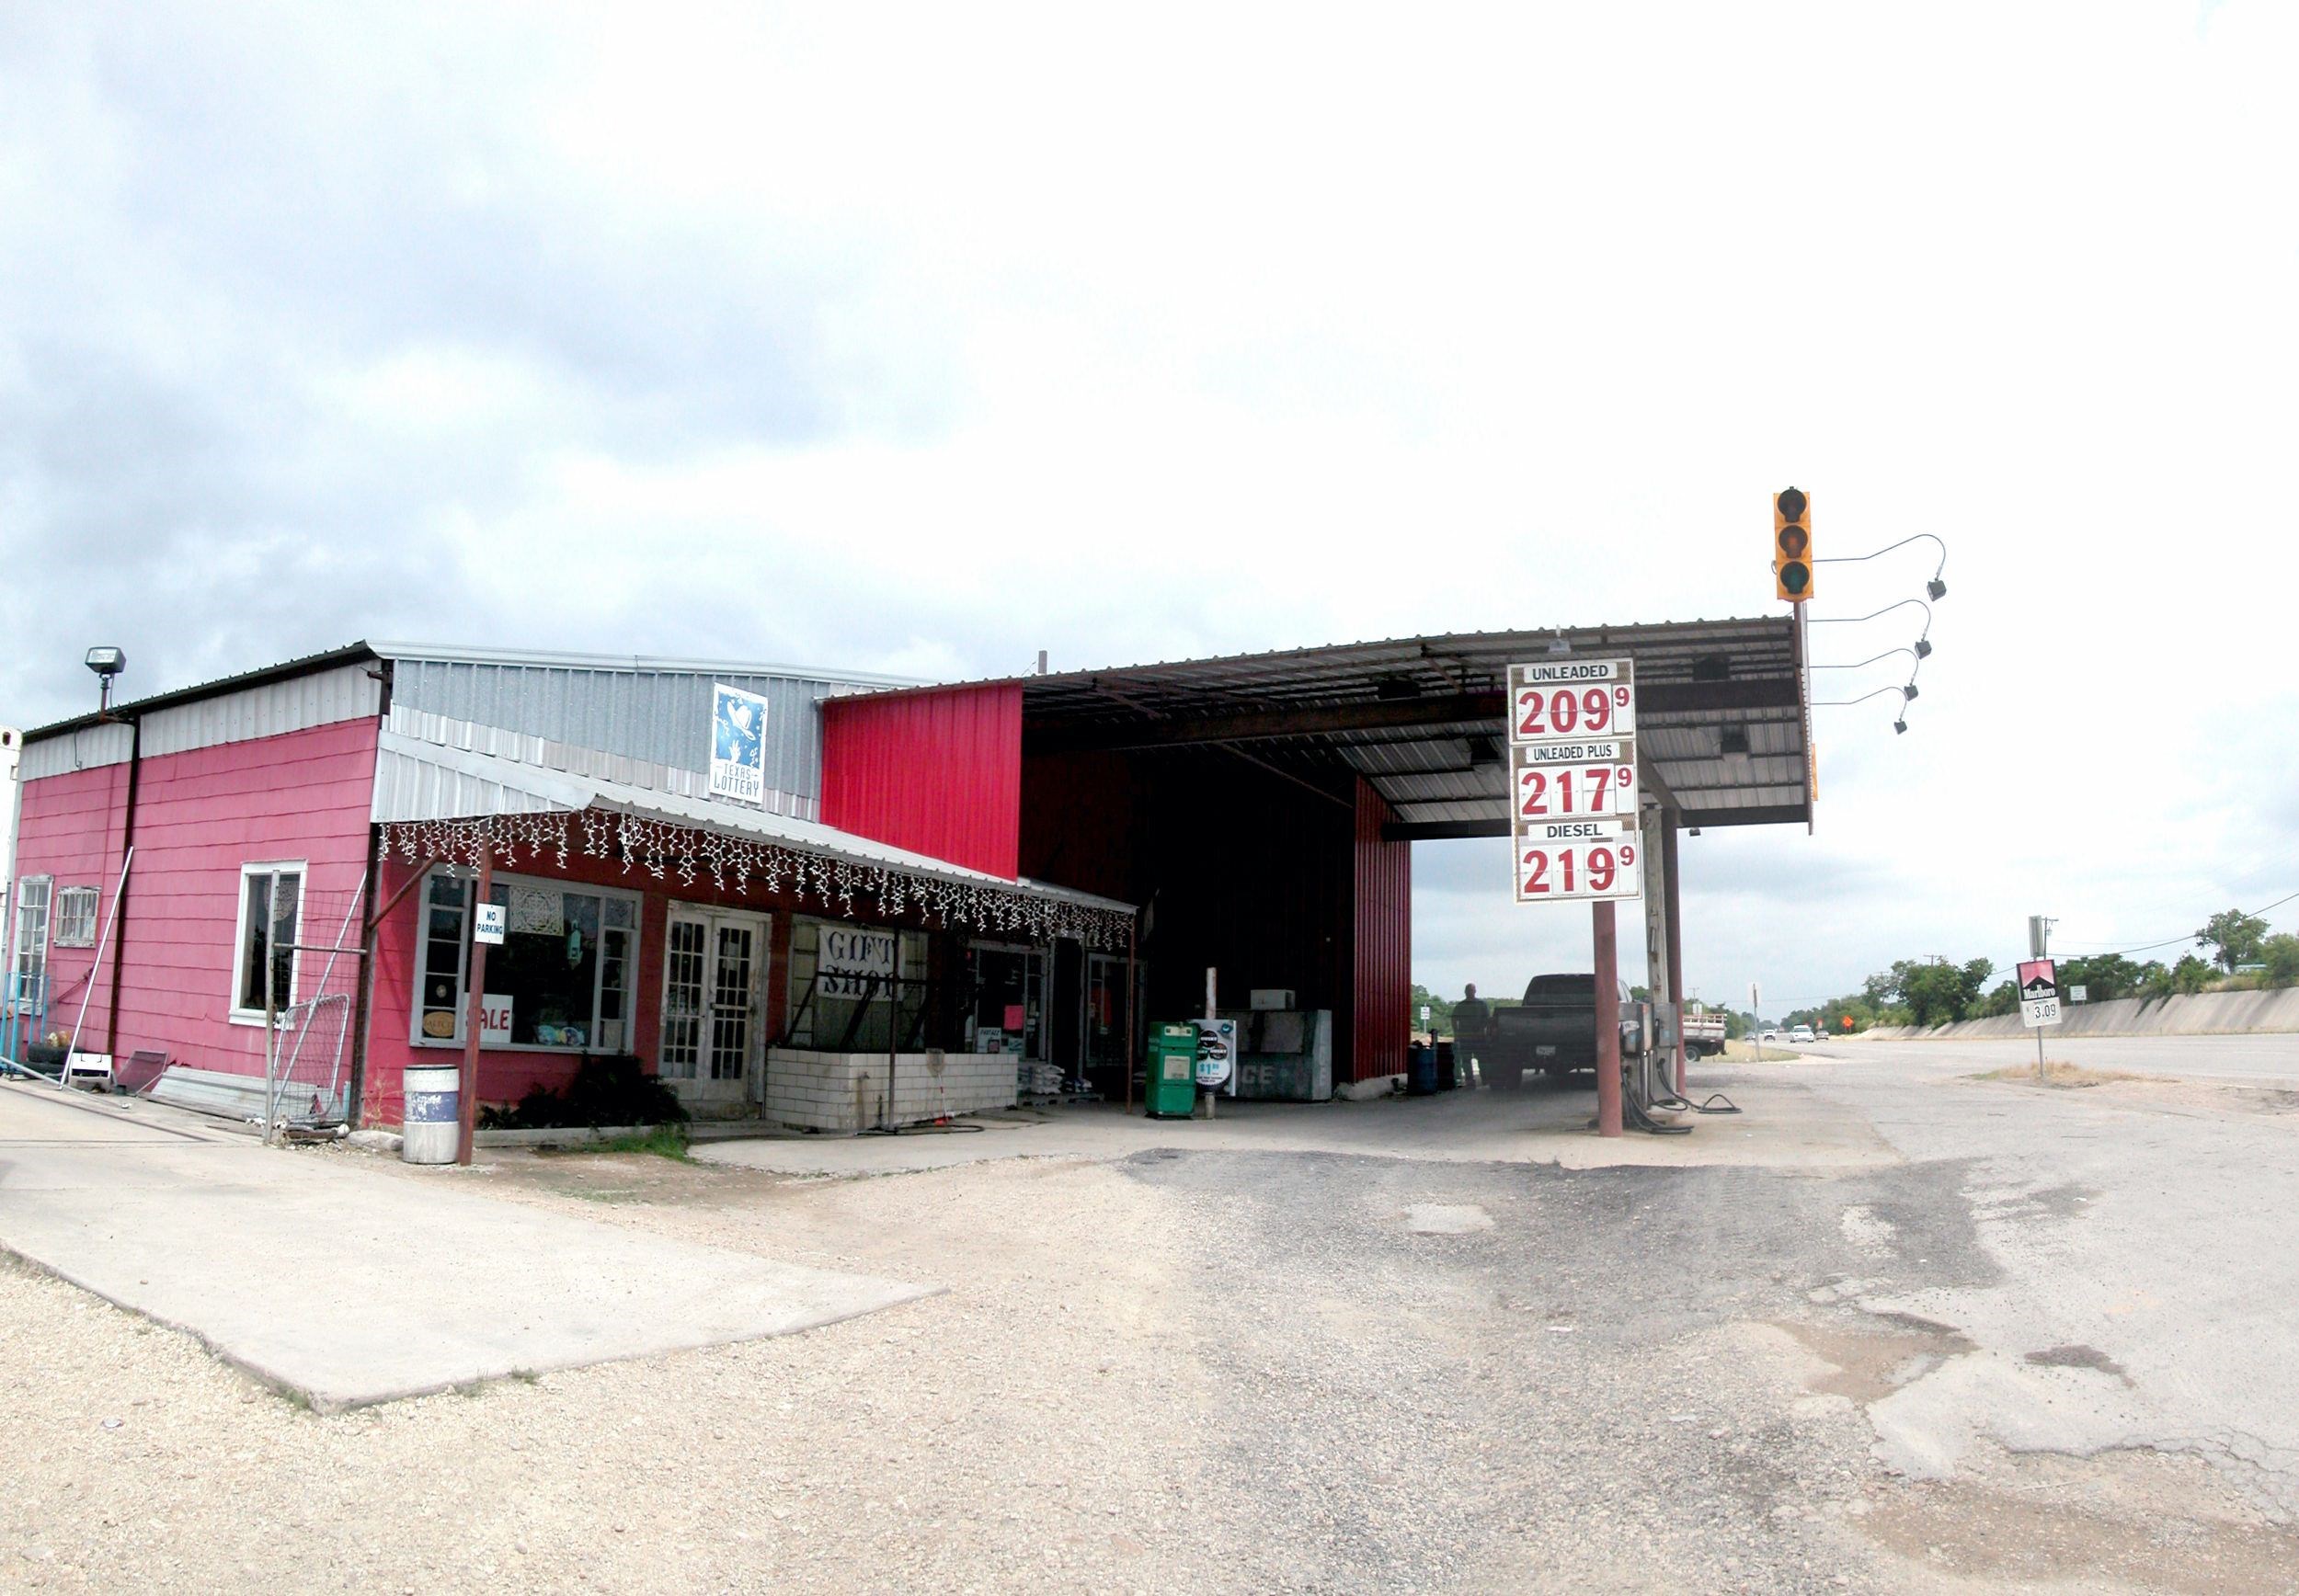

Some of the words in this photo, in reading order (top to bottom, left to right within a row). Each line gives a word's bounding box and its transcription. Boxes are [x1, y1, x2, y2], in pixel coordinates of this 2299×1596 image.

[1532, 664, 1608, 681] UNLEADED
[1533, 747, 1584, 761] UNLEADED
[1587, 744, 1612, 758] PLUS
[724, 763, 751, 780] TEXAS
[714, 771, 760, 797] LOTTERY
[1547, 823, 1603, 838] DIESEL
[486, 910, 497, 921] NO
[476, 923, 503, 935] PARKING
[829, 930, 896, 964] GIFT
[2023, 984, 2056, 1000] Marlboro
[465, 1008, 510, 1031] ALE
[2034, 1003, 2056, 1019] 3.09
